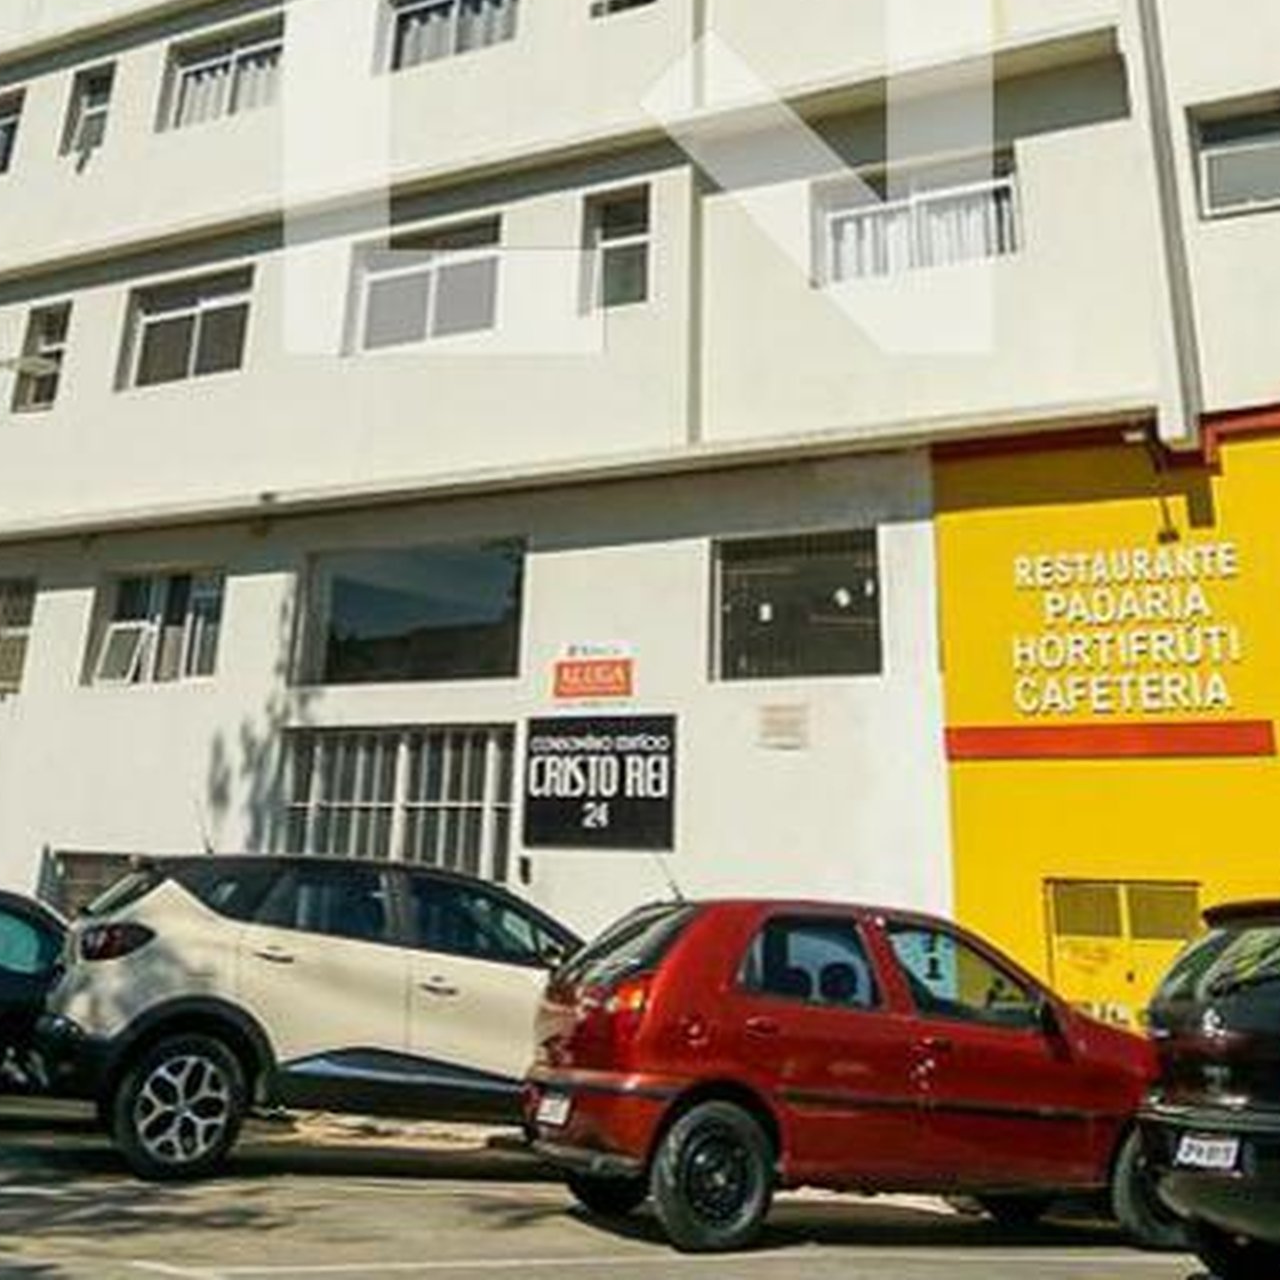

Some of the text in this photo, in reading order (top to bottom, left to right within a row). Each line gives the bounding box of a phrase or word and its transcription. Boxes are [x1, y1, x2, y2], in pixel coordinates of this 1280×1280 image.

[1014, 542, 1237, 586] RESTAURANTE
[1045, 584, 1210, 624] PADARIA
[1014, 671, 1231, 713] CAFETERIA
[529, 754, 669, 798] CRISTO REI
[581, 800, 610, 828] 24
